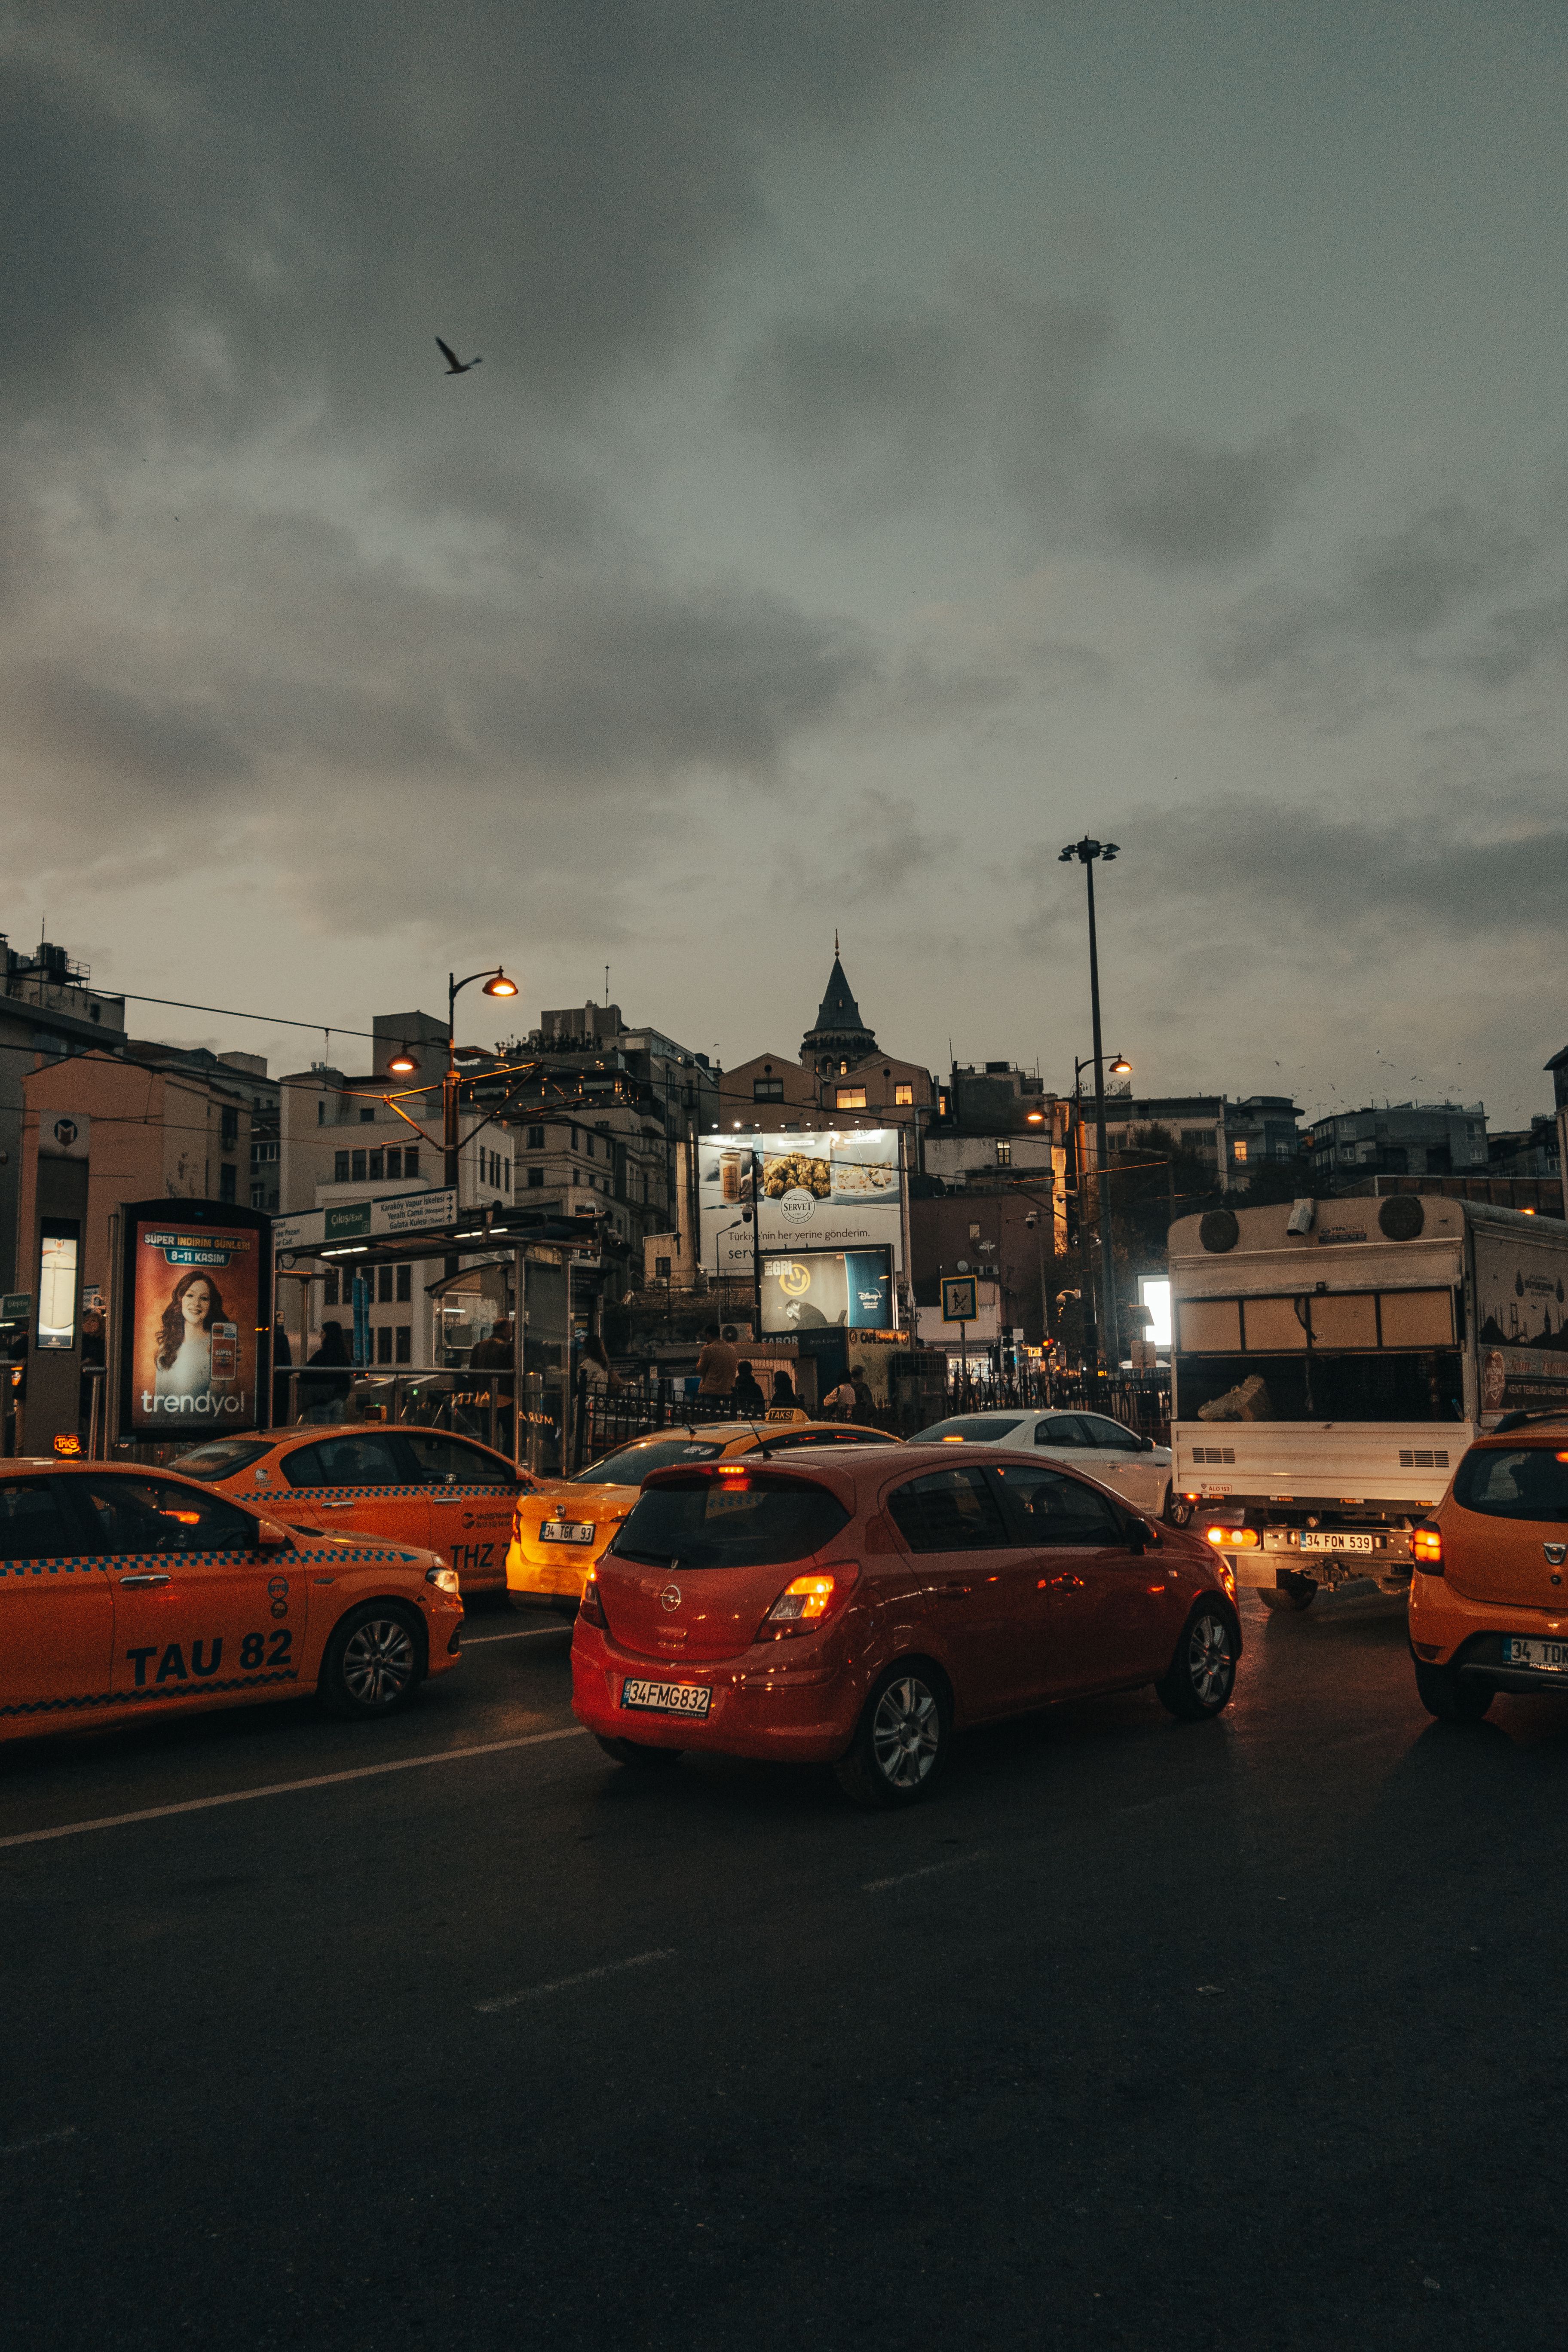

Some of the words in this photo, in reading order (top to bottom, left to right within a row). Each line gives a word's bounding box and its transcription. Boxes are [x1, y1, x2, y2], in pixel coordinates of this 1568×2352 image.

[405, 1200, 422, 1208] Vapur
[784, 1202, 812, 1212] SERVET
[144, 1233, 175, 1245] SÜPER
[778, 1230, 792, 1239] her
[795, 1230, 822, 1241] yerine
[825, 1228, 870, 1241] gönderim.
[172, 1251, 192, 1262] 8-11
[195, 1253, 225, 1263] KASIM
[141, 1390, 244, 1417] trendyol
[545, 1525, 554, 1537] 34
[560, 1525, 574, 1539] TGK
[580, 1527, 591, 1540] 93
[1307, 1534, 1320, 1547] 34
[1325, 1535, 1344, 1548] FON
[1350, 1537, 1369, 1549] 539
[450, 1543, 495, 1569] THZ
[126, 1637, 223, 1686] TAU
[240, 1629, 292, 1669] 82
[1513, 1641, 1531, 1660] 34
[630, 1682, 708, 1711] 34FMG832
